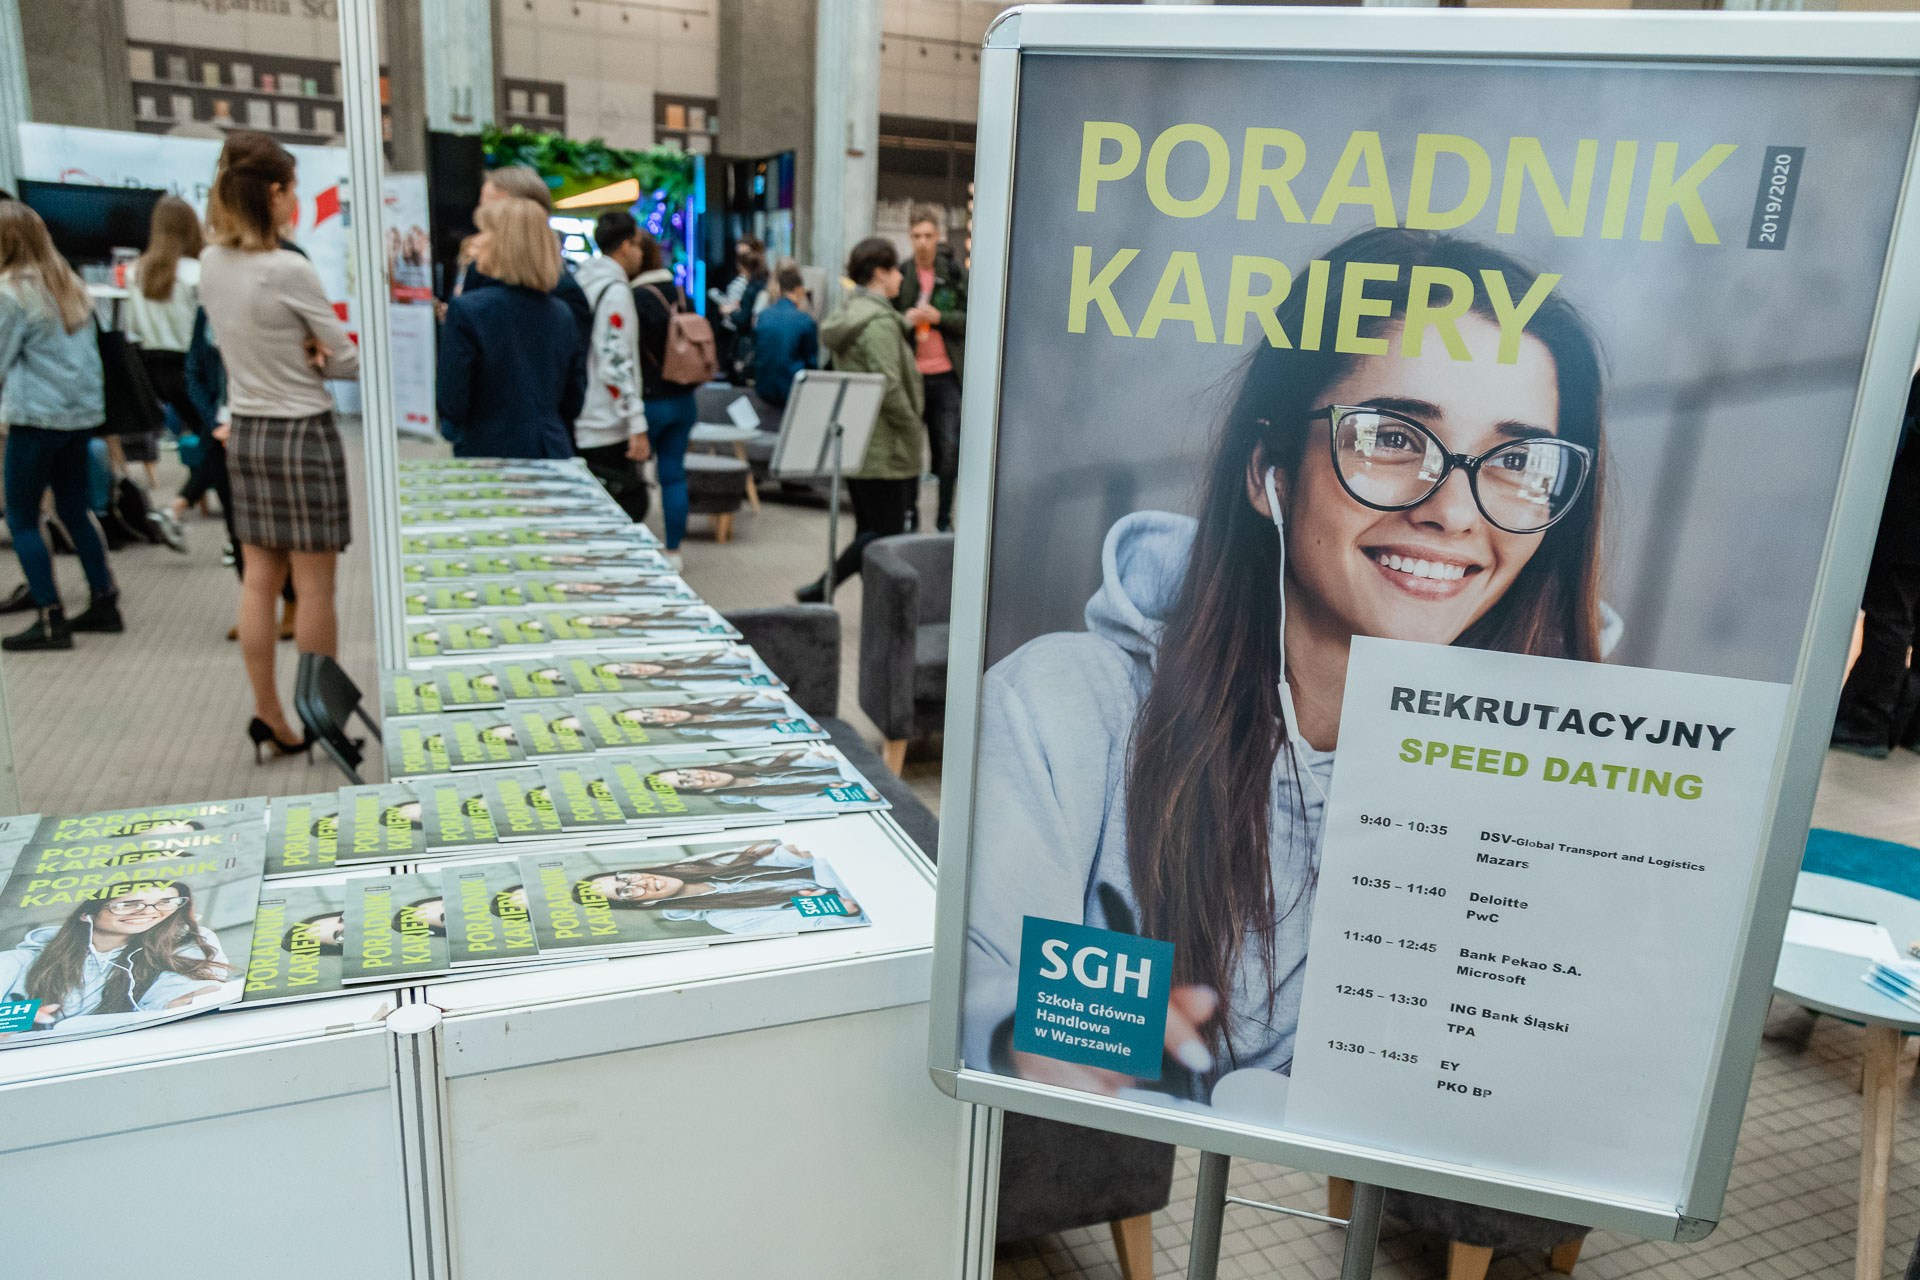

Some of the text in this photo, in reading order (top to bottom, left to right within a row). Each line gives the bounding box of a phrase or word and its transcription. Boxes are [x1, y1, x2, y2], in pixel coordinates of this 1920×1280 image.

[1076, 120, 1739, 245] PORADNIK
[1759, 154, 1792, 243] 2019/2020
[1066, 245, 1563, 365] KARIERY
[1390, 686, 1735, 751] REKRUTACYJNY
[1399, 738, 1704, 800] SPEED DATING
[52, 818, 193, 842] KARIERY
[58, 804, 230, 830] PORADNIK
[1360, 814, 1391, 828] 9:40
[1407, 821, 1448, 836] 10:35
[35, 849, 184, 874] KARIERY
[41, 834, 223, 861] PORADNIK
[1476, 853, 1530, 870] Mazars
[1480, 831, 1706, 873] DSV-Global Transport and Logistics
[26, 860, 220, 892] PORADNIK
[1352, 875, 1391, 890] 10:35
[1407, 883, 1447, 898] 11:40
[20, 878, 177, 908] KARIERY
[539, 867, 583, 939] PORADNIK
[576, 880, 619, 936] KARIERY
[1469, 892, 1529, 909] Deloitte
[362, 892, 392, 968] PORADNIK
[460, 878, 496, 952] PORADNIK
[496, 892, 534, 949] KARIERY
[1466, 910, 1500, 923] PwC
[245, 905, 286, 992] PORADNIK
[400, 906, 432, 964] KARIERY
[1344, 930, 1382, 945] 11:40
[1398, 939, 1437, 953] 12:45
[287, 922, 320, 987] KARIERY
[1039, 938, 1152, 998] SGH
[1459, 948, 1582, 977] Bank Pekao S.A.
[1456, 965, 1526, 986] Microsoft
[1037, 991, 1146, 1025] Szkoła Główna
[1335, 984, 1374, 999] 12:45
[1389, 993, 1428, 1008] 13:30
[1036, 1008, 1111, 1035] Handlowa
[1447, 1023, 1476, 1037] TPA
[1450, 1003, 1569, 1033] ING Bank Śląski
[1034, 1027, 1131, 1057] w Warszawie
[1327, 1040, 1365, 1055] 13:30
[1380, 1049, 1418, 1064] 14:35
[1440, 1060, 1460, 1072] EY
[1436, 1080, 1492, 1098] PKO BP
